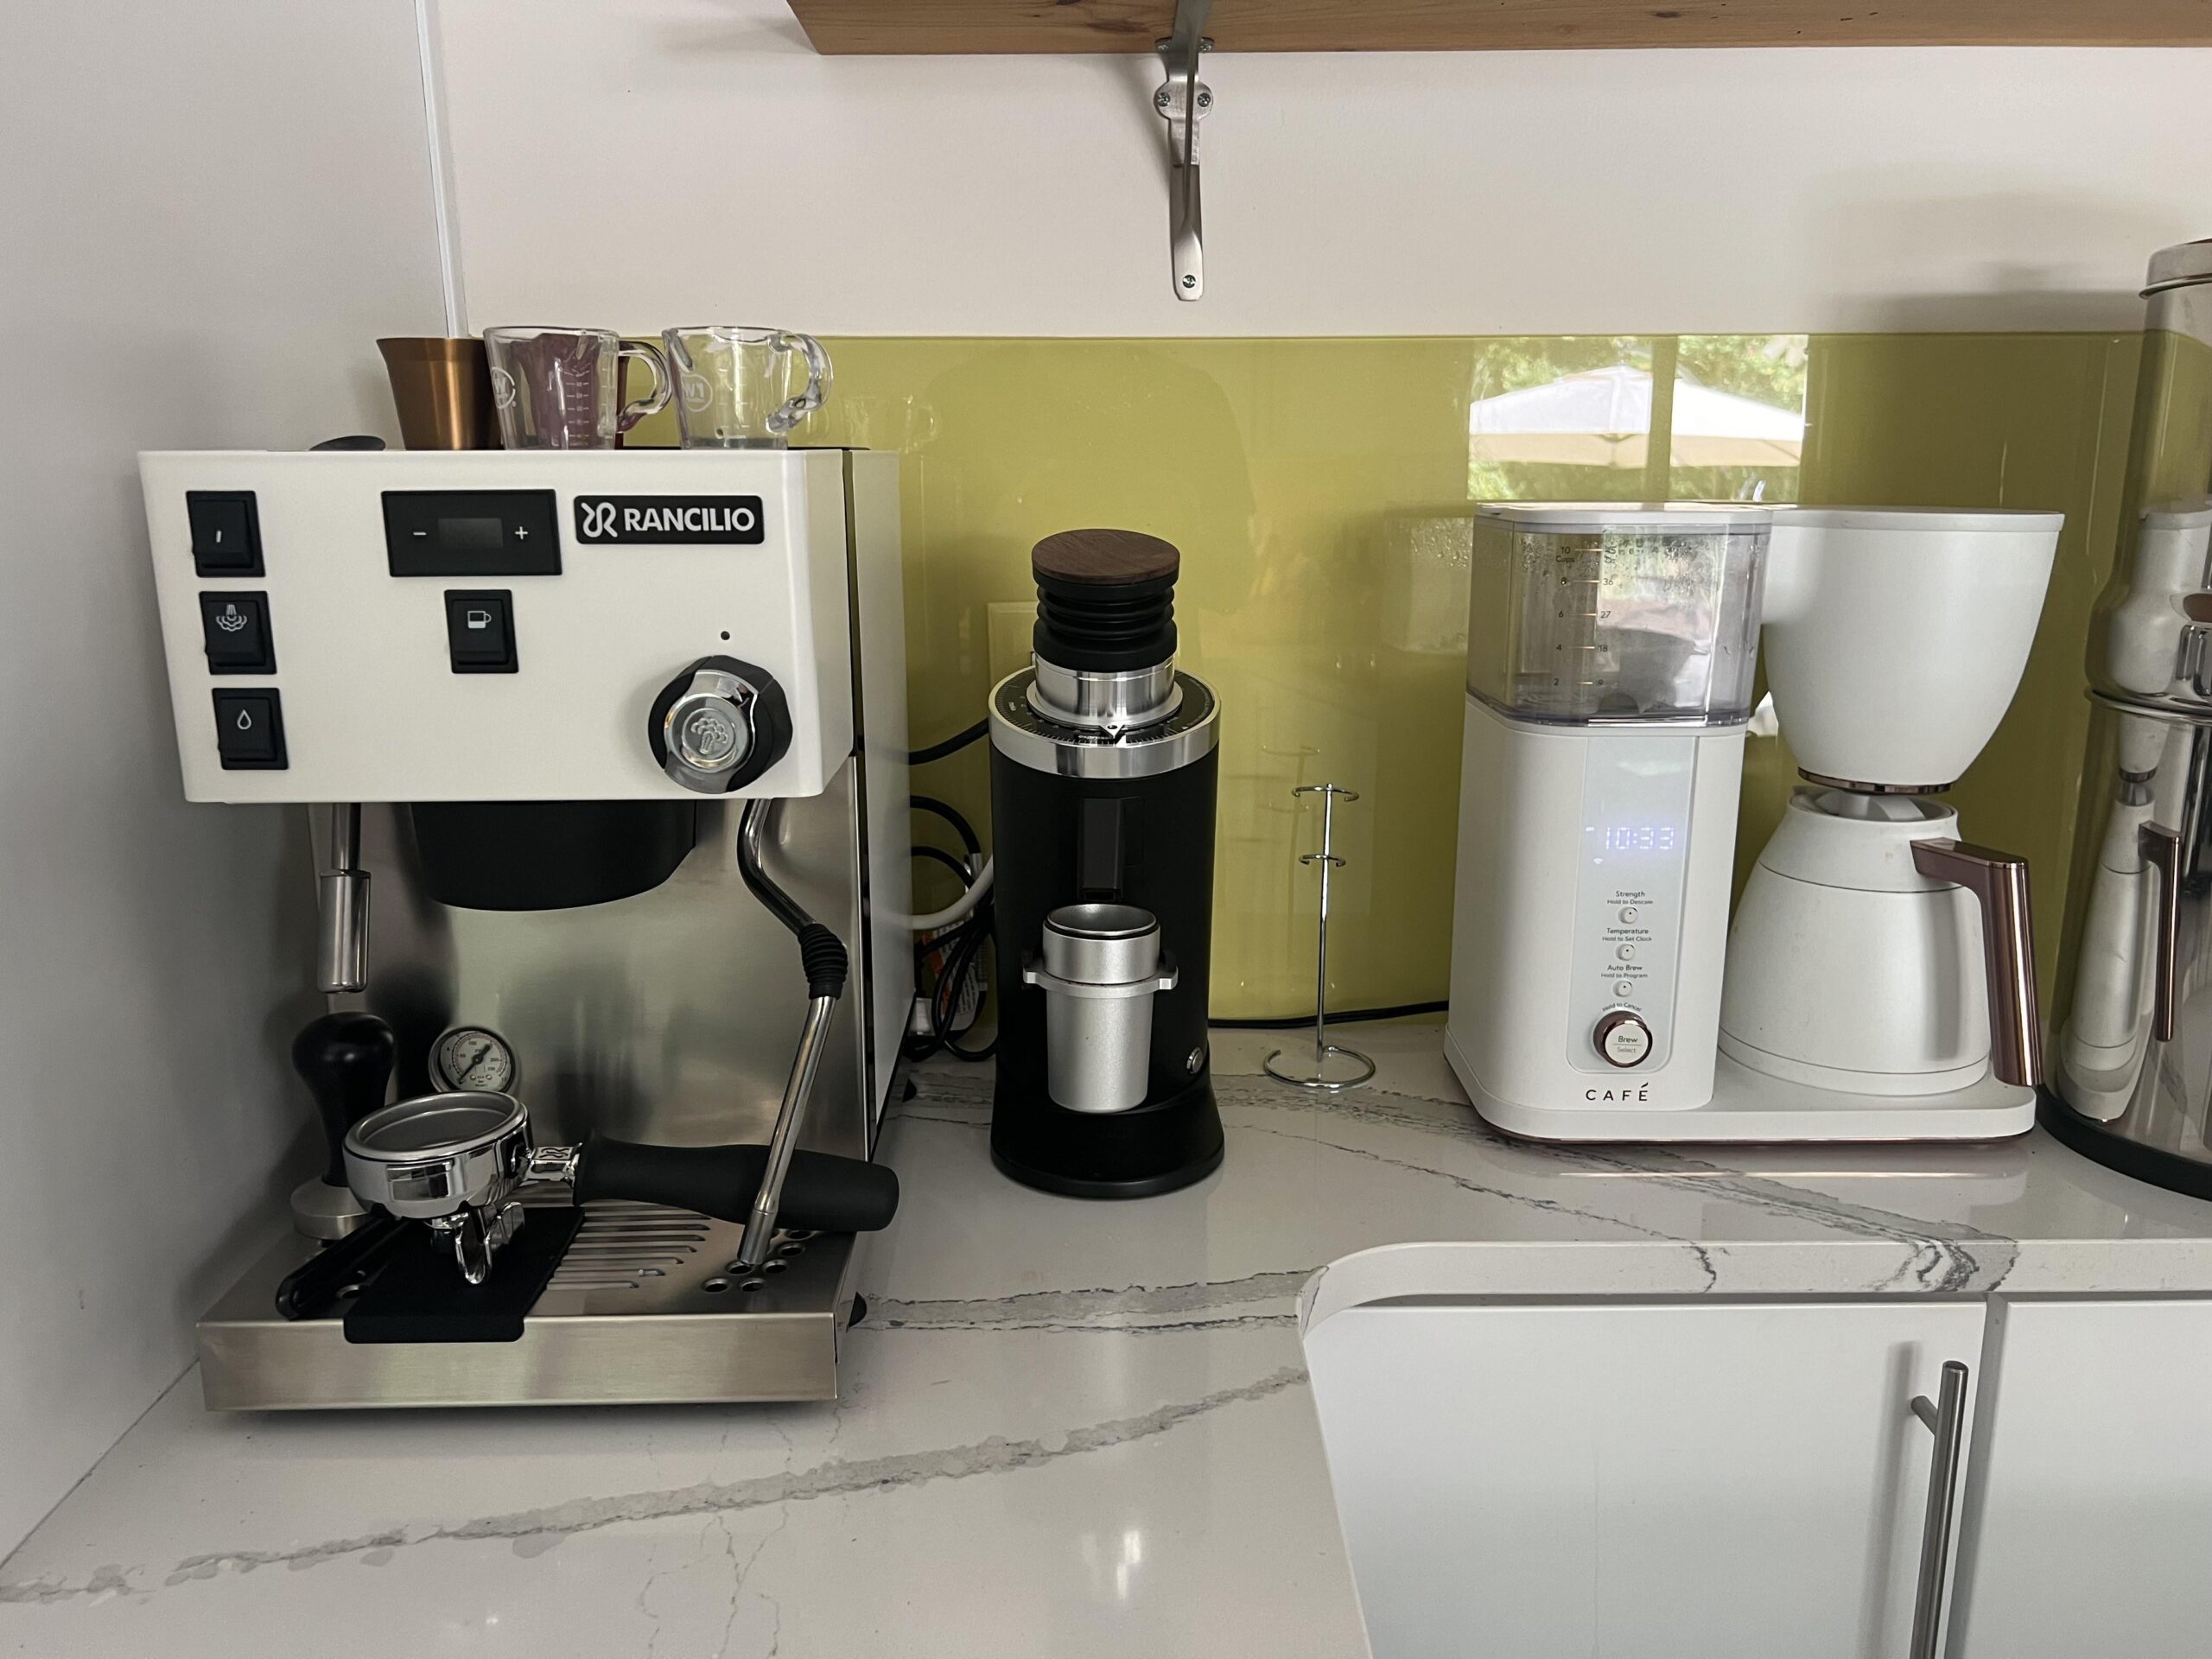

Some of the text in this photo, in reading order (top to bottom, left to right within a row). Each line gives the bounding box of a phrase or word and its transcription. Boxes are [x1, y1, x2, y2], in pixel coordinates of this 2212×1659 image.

[624, 508, 755, 531] RANCILIO
[1555, 555, 1574, 564] Cups
[1558, 610, 1564, 619] 6
[1600, 610, 1611, 619] 27
[1605, 827, 1675, 850] 10:33
[1606, 927, 1649, 936] Temperature
[1586, 1082, 1649, 1102] CAFÉ
